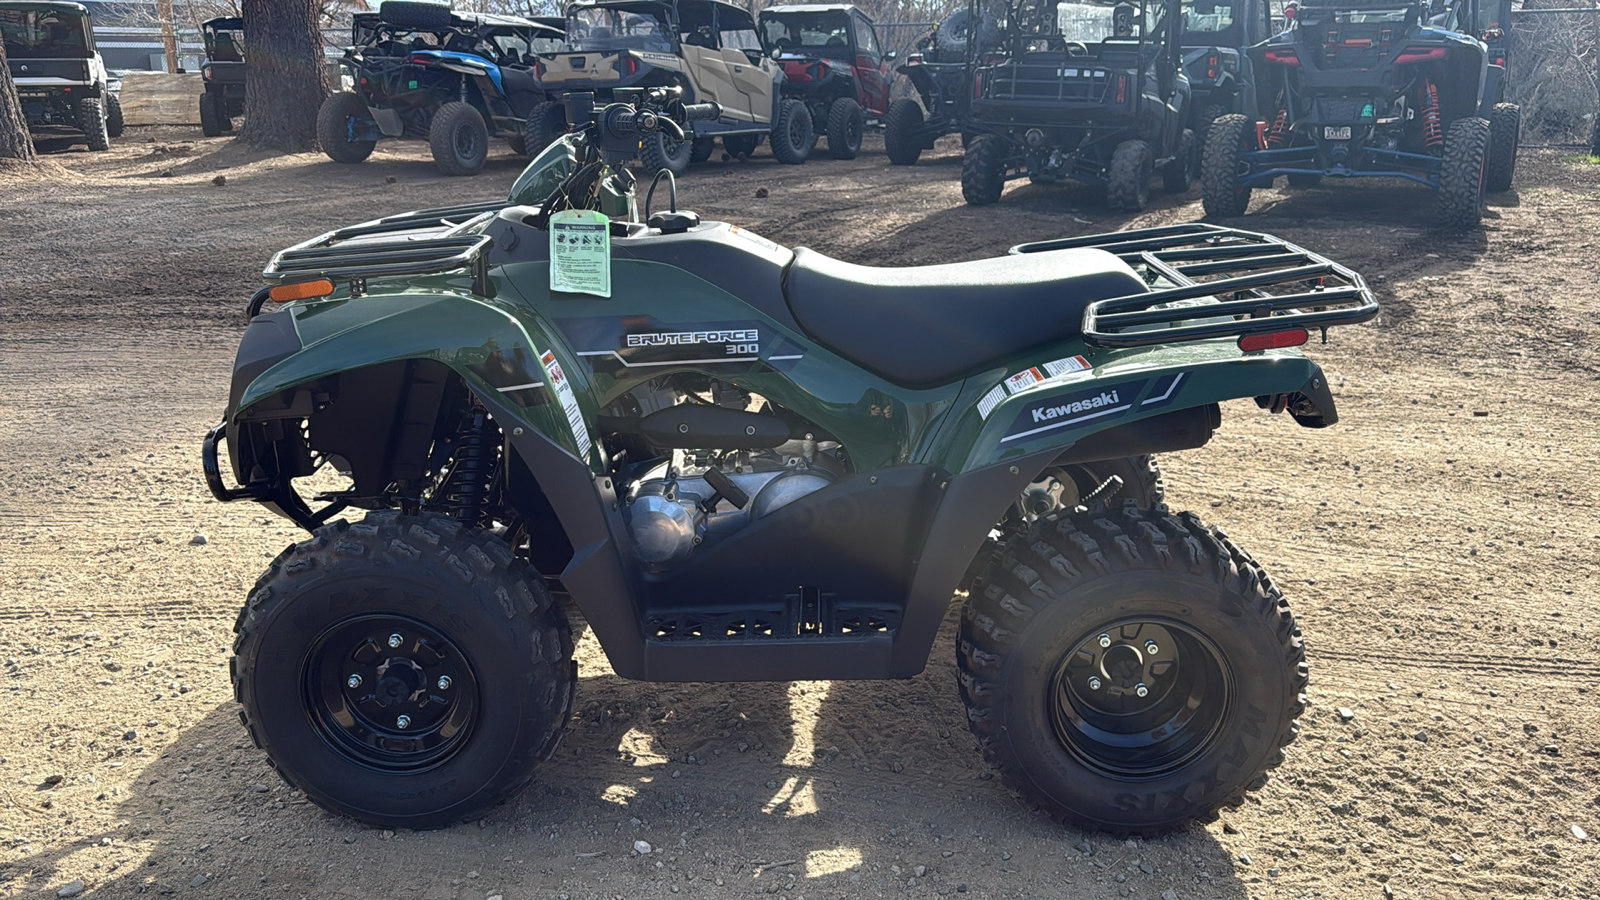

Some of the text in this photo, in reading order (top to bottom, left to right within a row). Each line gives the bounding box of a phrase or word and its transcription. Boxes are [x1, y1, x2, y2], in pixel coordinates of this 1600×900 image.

[627, 329, 758, 346] BRUTE FORCE
[726, 344, 759, 354] 300
[1031, 390, 1120, 422] Kawasaki
[1113, 702, 1269, 813] MAXXIS
